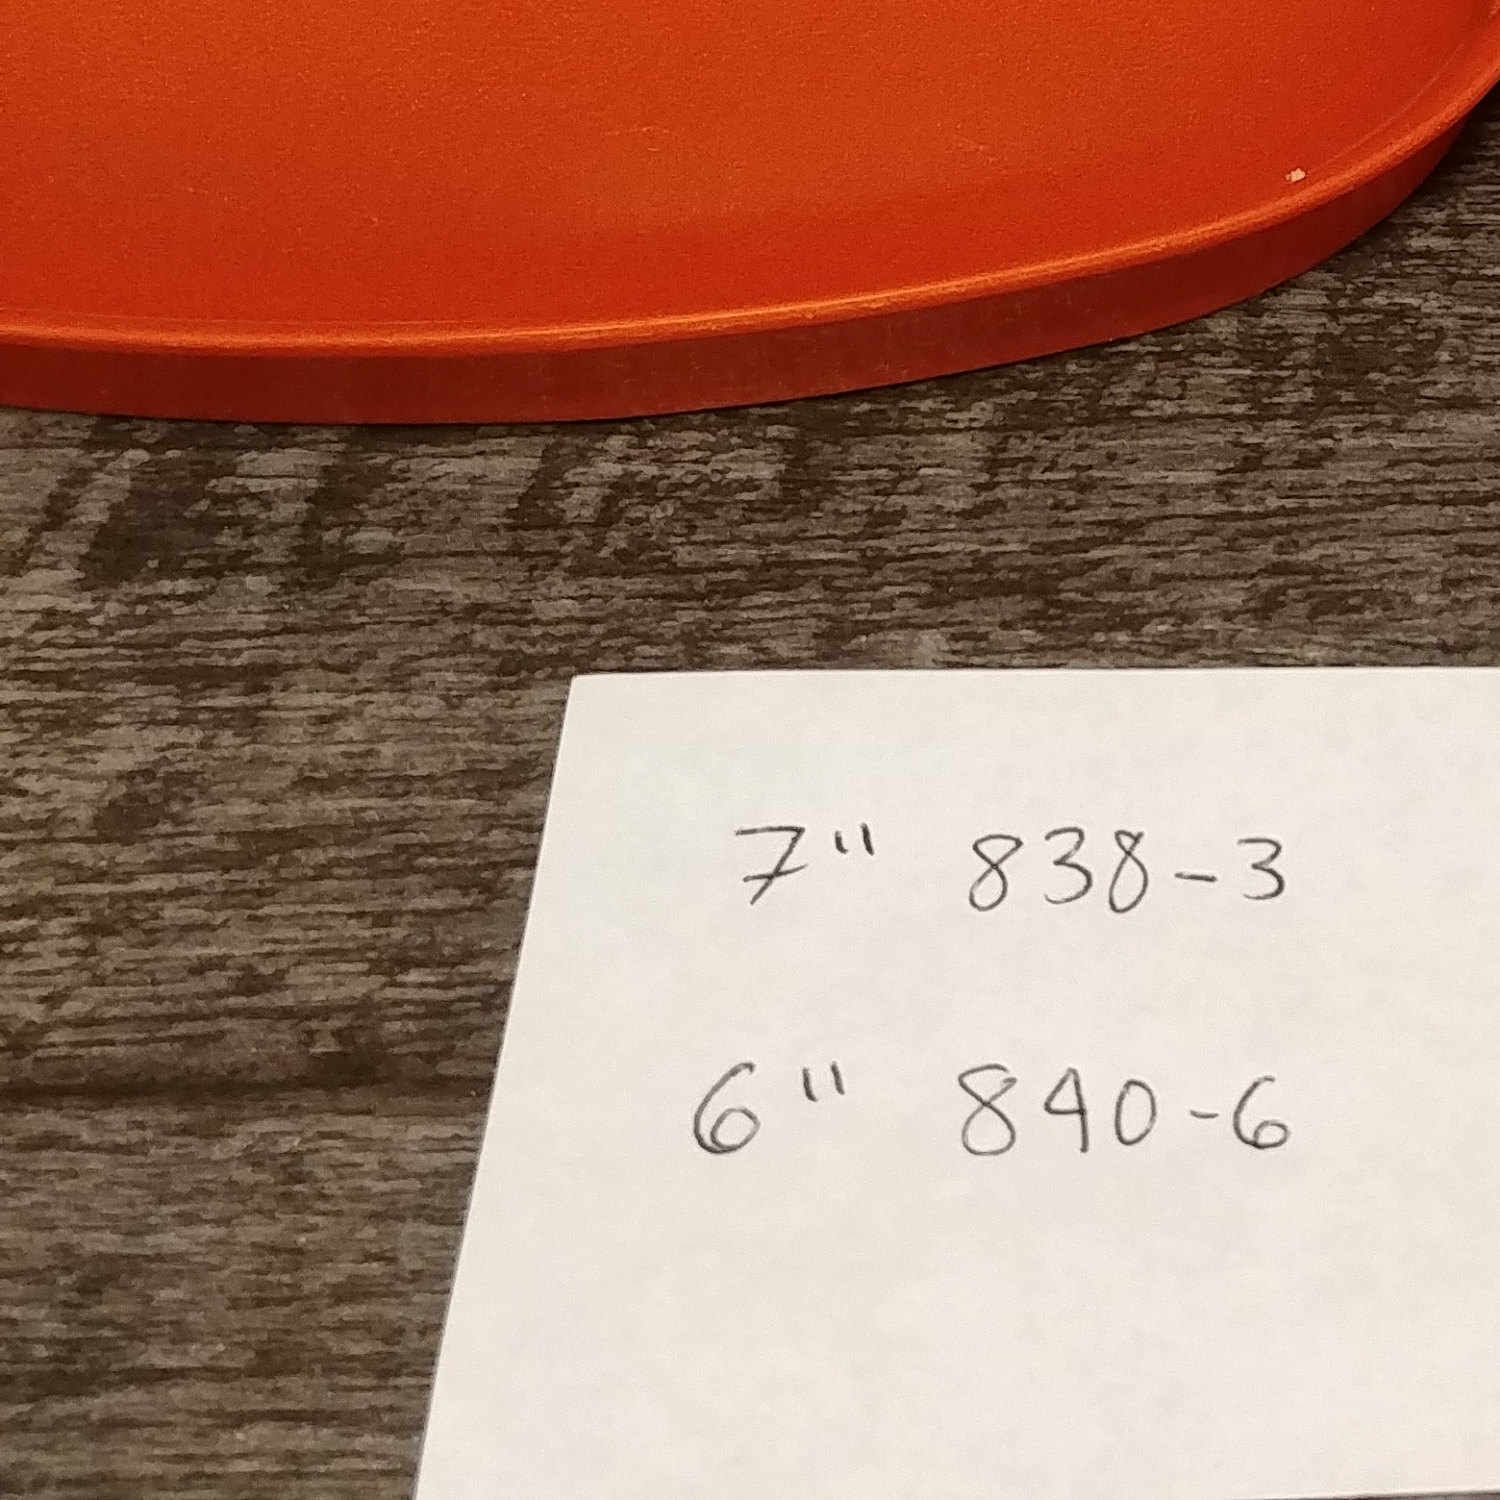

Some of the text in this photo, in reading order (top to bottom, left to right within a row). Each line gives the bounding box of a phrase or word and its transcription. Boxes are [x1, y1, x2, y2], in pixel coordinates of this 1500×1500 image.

[734, 822, 1286, 914] 7" 838-3
[692, 1061, 1291, 1157] 6" 840-6
